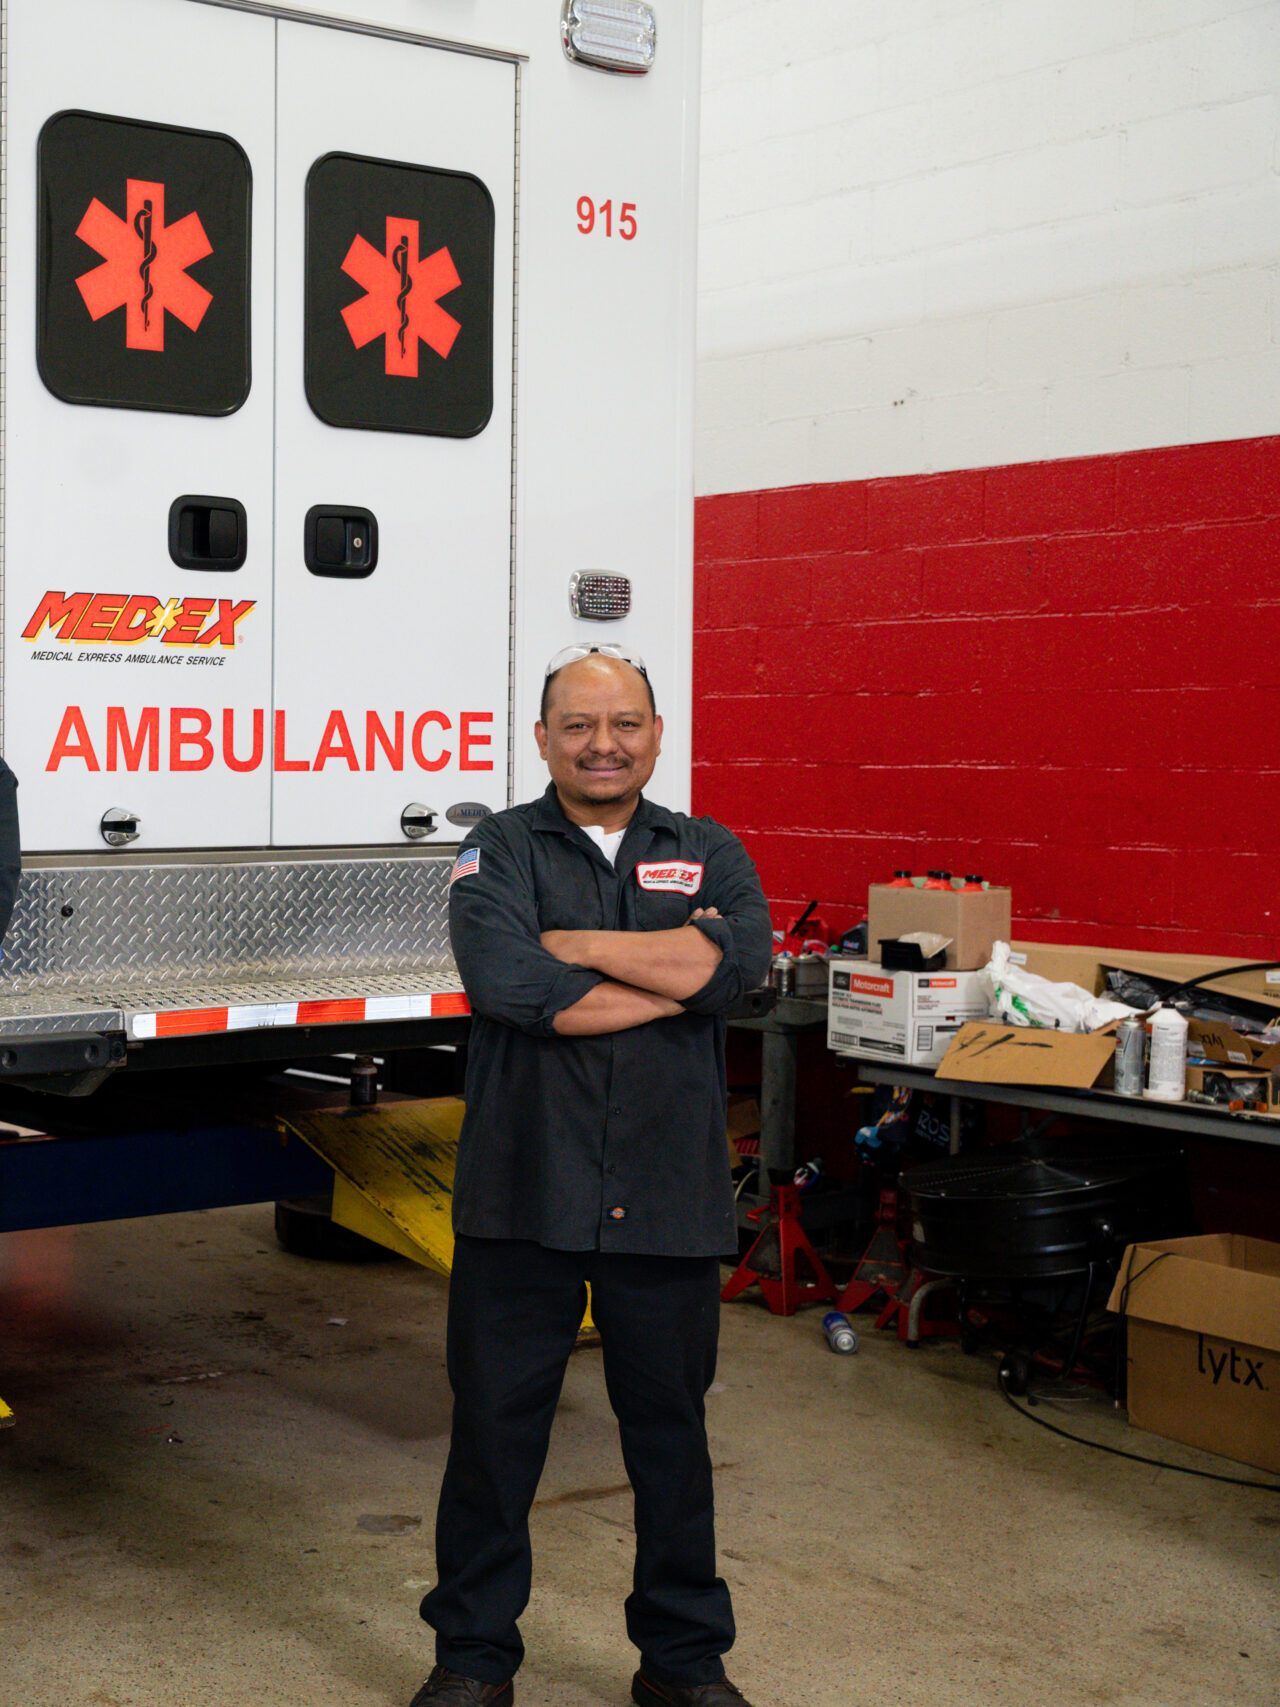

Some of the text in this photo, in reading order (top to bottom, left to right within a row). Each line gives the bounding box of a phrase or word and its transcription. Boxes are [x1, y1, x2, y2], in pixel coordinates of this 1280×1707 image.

[576, 195, 637, 241] 915
[31, 651, 226, 666] MEDICAL EXPRESS AMBULANCE SERVICE
[45, 705, 494, 773] AMBULANCE
[853, 979, 890, 994] Motorcraft
[1198, 1332, 1265, 1391] lytx
